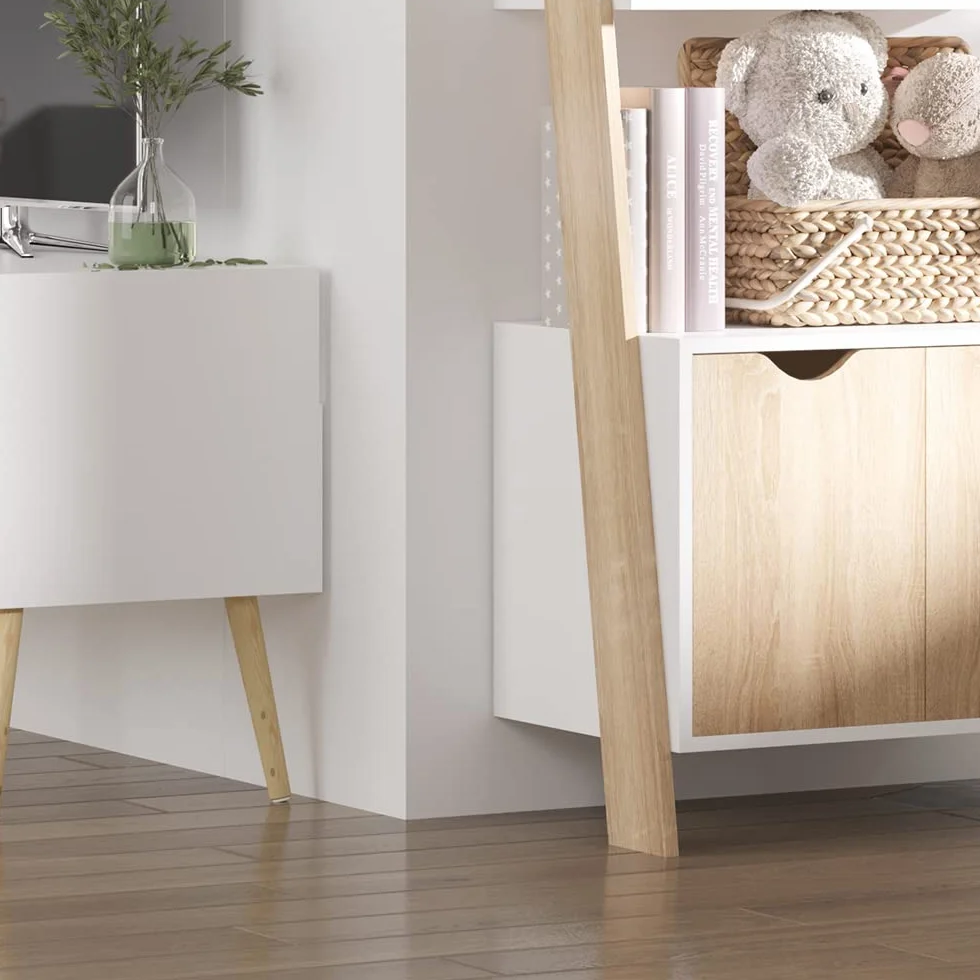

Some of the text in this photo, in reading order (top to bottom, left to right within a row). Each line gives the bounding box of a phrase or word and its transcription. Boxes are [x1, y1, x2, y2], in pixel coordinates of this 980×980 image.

[699, 143, 707, 171] David
[708, 119, 719, 183] RECOVERY
[666, 154, 678, 200] ALICE
[708, 206, 719, 255] MENTAL
[708, 256, 719, 305] HEALTH
